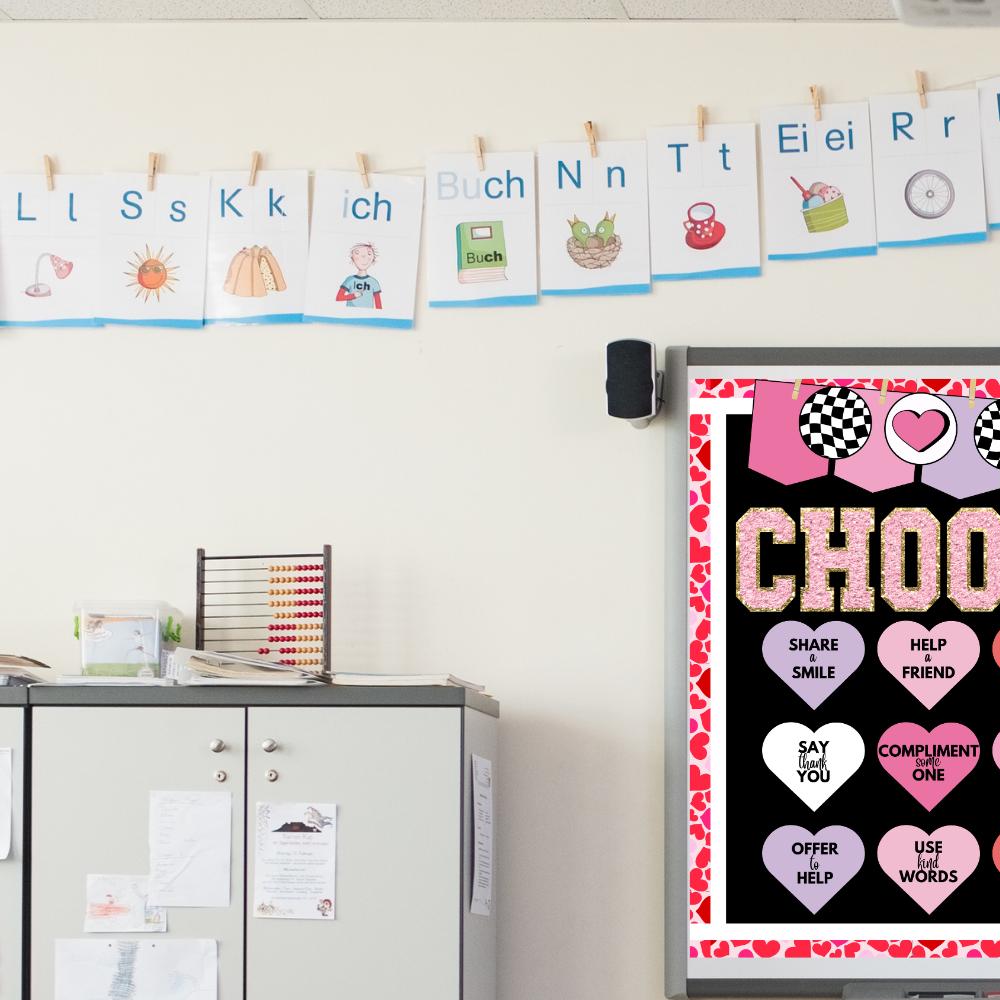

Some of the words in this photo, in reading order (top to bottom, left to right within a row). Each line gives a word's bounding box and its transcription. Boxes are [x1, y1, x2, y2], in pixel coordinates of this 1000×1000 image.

[892, 112, 914, 140] R
[944, 116, 955, 138] r
[778, 124, 808, 153] Ei
[826, 121, 853, 151] ei
[668, 144, 688, 172] T
[719, 143, 731, 170] t
[558, 160, 581, 189] N
[607, 167, 625, 188] n
[437, 170, 525, 200] Buch
[18, 192, 36, 221] L
[121, 191, 142, 219] S
[170, 201, 186, 222] s
[221, 189, 242, 217] K
[269, 188, 286, 216] k
[341, 189, 392, 221] ich
[466, 248, 503, 265] Buch
[352, 280, 371, 292] ich
[788, 638, 839, 651] SHARE
[910, 638, 947, 651] HELP
[809, 653, 817, 663] a
[924, 653, 932, 663] a
[792, 666, 835, 679] SMILE
[902, 666, 956, 679] FRIEND
[798, 740, 830, 754] SAY
[878, 744, 979, 757] COMPLIMENT
[798, 754, 828, 770] thank
[915, 756, 941, 768] some
[796, 770, 831, 783] YOU
[912, 769, 945, 781] ONE
[791, 842, 839, 855] OFFER
[914, 840, 943, 854] USE
[809, 853, 819, 871] to
[917, 852, 939, 870] kind
[796, 871, 834, 885] HELP
[899, 870, 958, 883] WORDS
